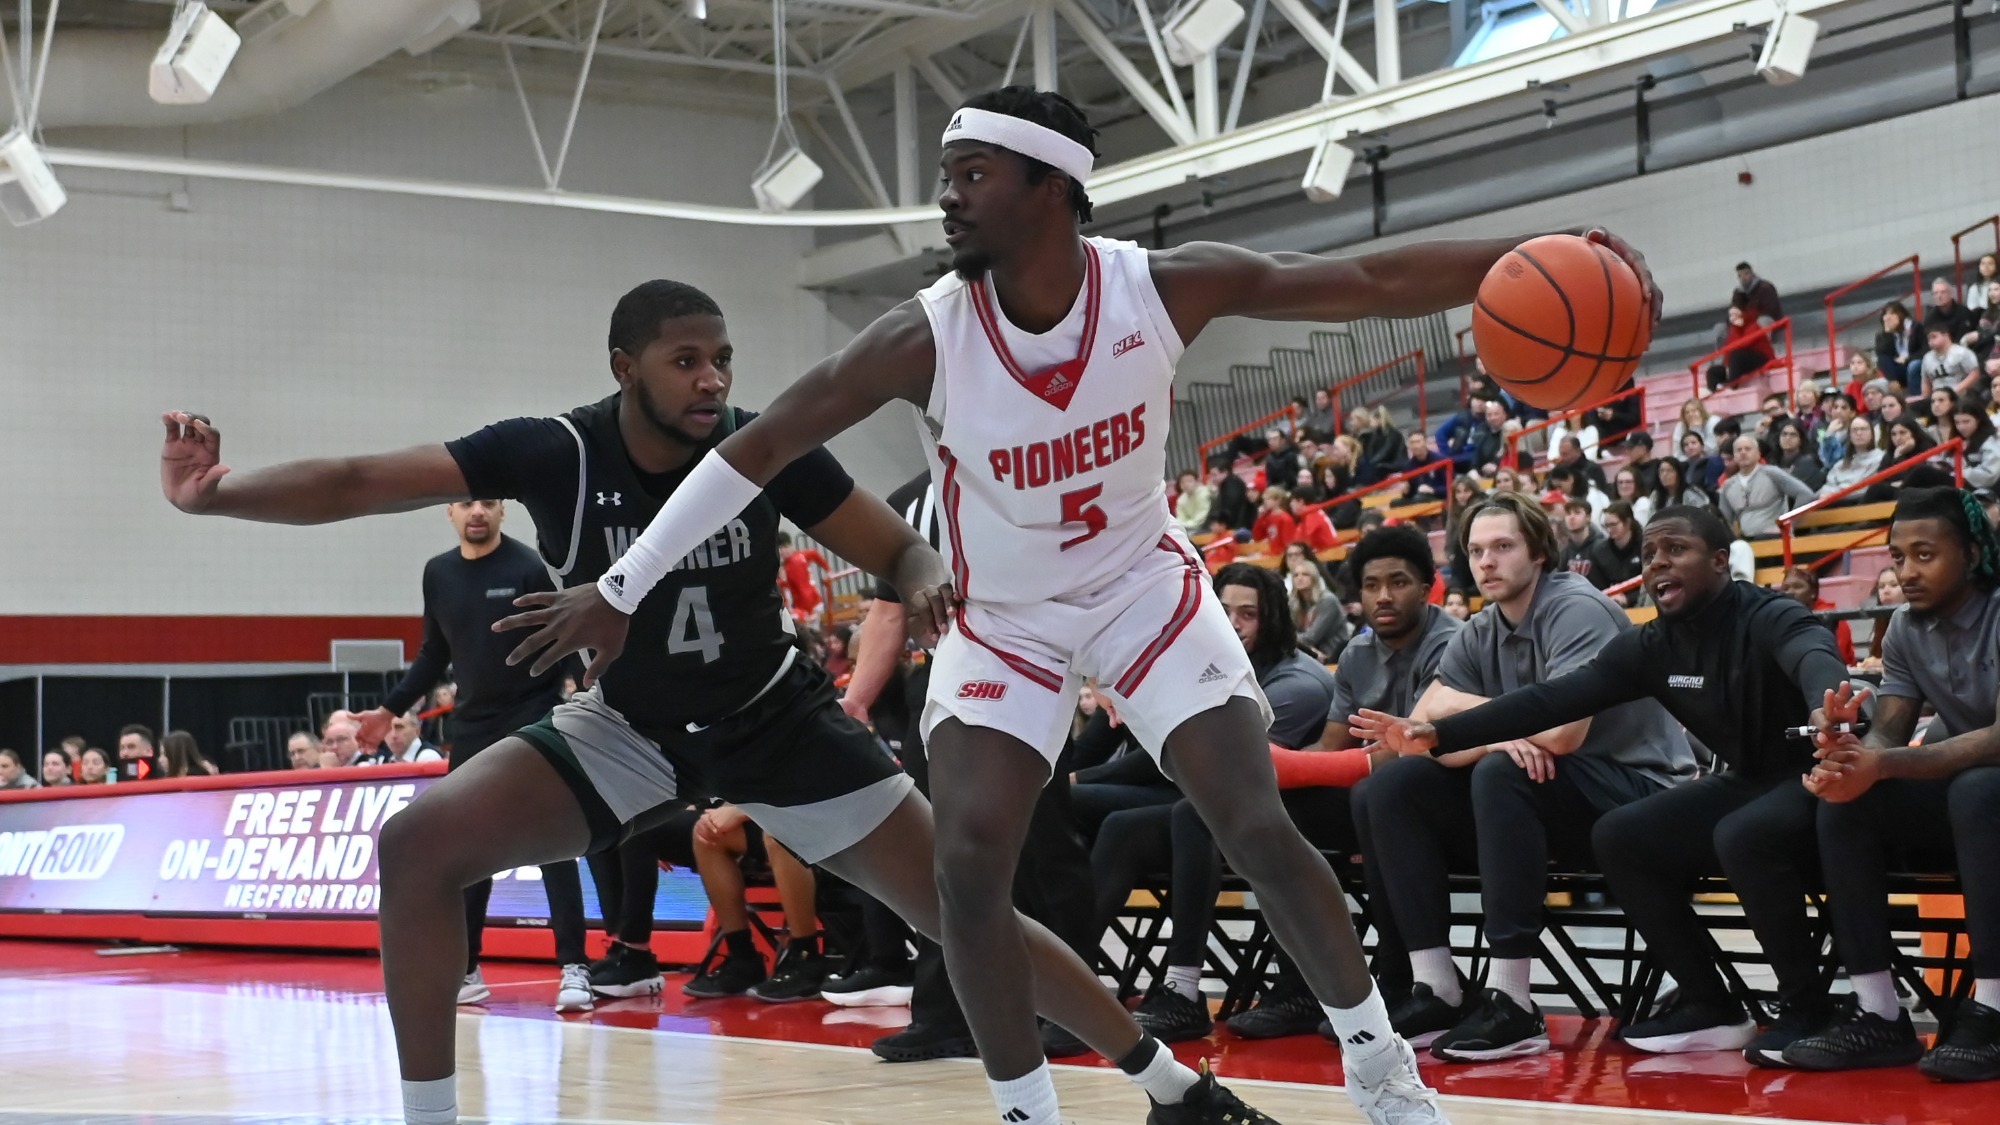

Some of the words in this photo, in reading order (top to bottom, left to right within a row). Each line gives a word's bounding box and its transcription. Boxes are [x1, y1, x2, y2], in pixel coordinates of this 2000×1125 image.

[1112, 330, 1143, 357] NEC
[1044, 381, 1074, 397] adidas
[988, 401, 1146, 491] PIONEERS
[1060, 481, 1109, 553] 5
[667, 586, 725, 664] 4
[957, 680, 1008, 700] SHU
[1198, 673, 1228, 684] adidas
[224, 789, 322, 836] FREE
[39, 831, 115, 874] ROW
[159, 835, 374, 881] ON-DEMAND
